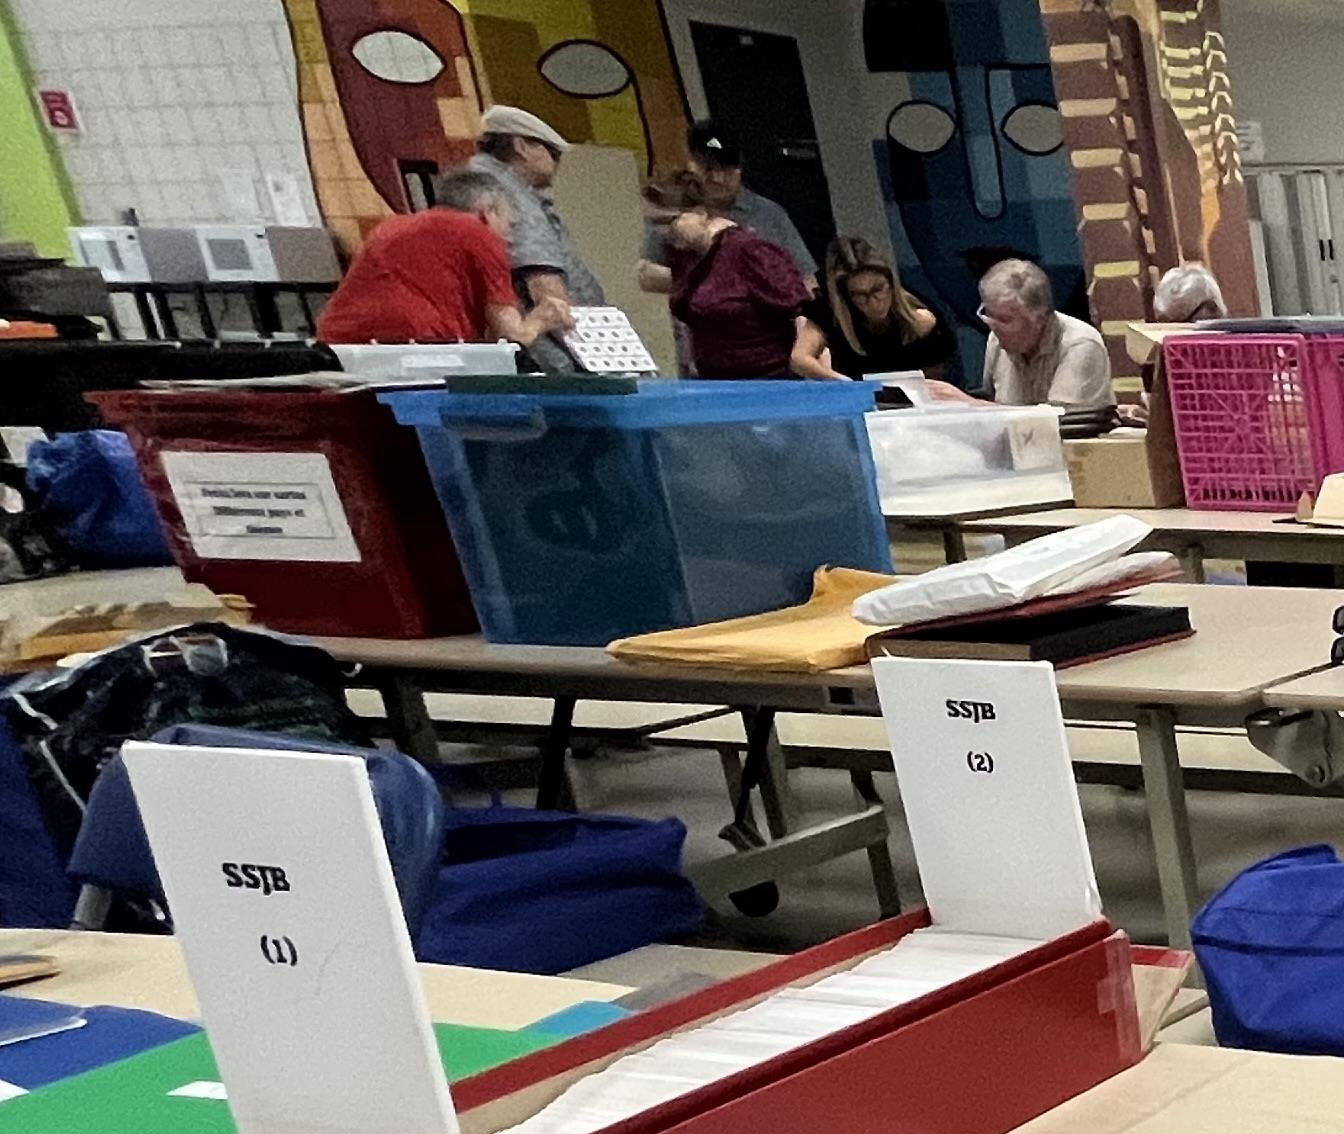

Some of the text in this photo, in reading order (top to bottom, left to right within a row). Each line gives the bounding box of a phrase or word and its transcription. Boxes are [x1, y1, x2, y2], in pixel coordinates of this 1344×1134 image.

[946, 699, 996, 723] SSJB
[966, 751, 994, 773] (2)
[222, 862, 290, 896] SSJB
[260, 935, 297, 967] (1)
